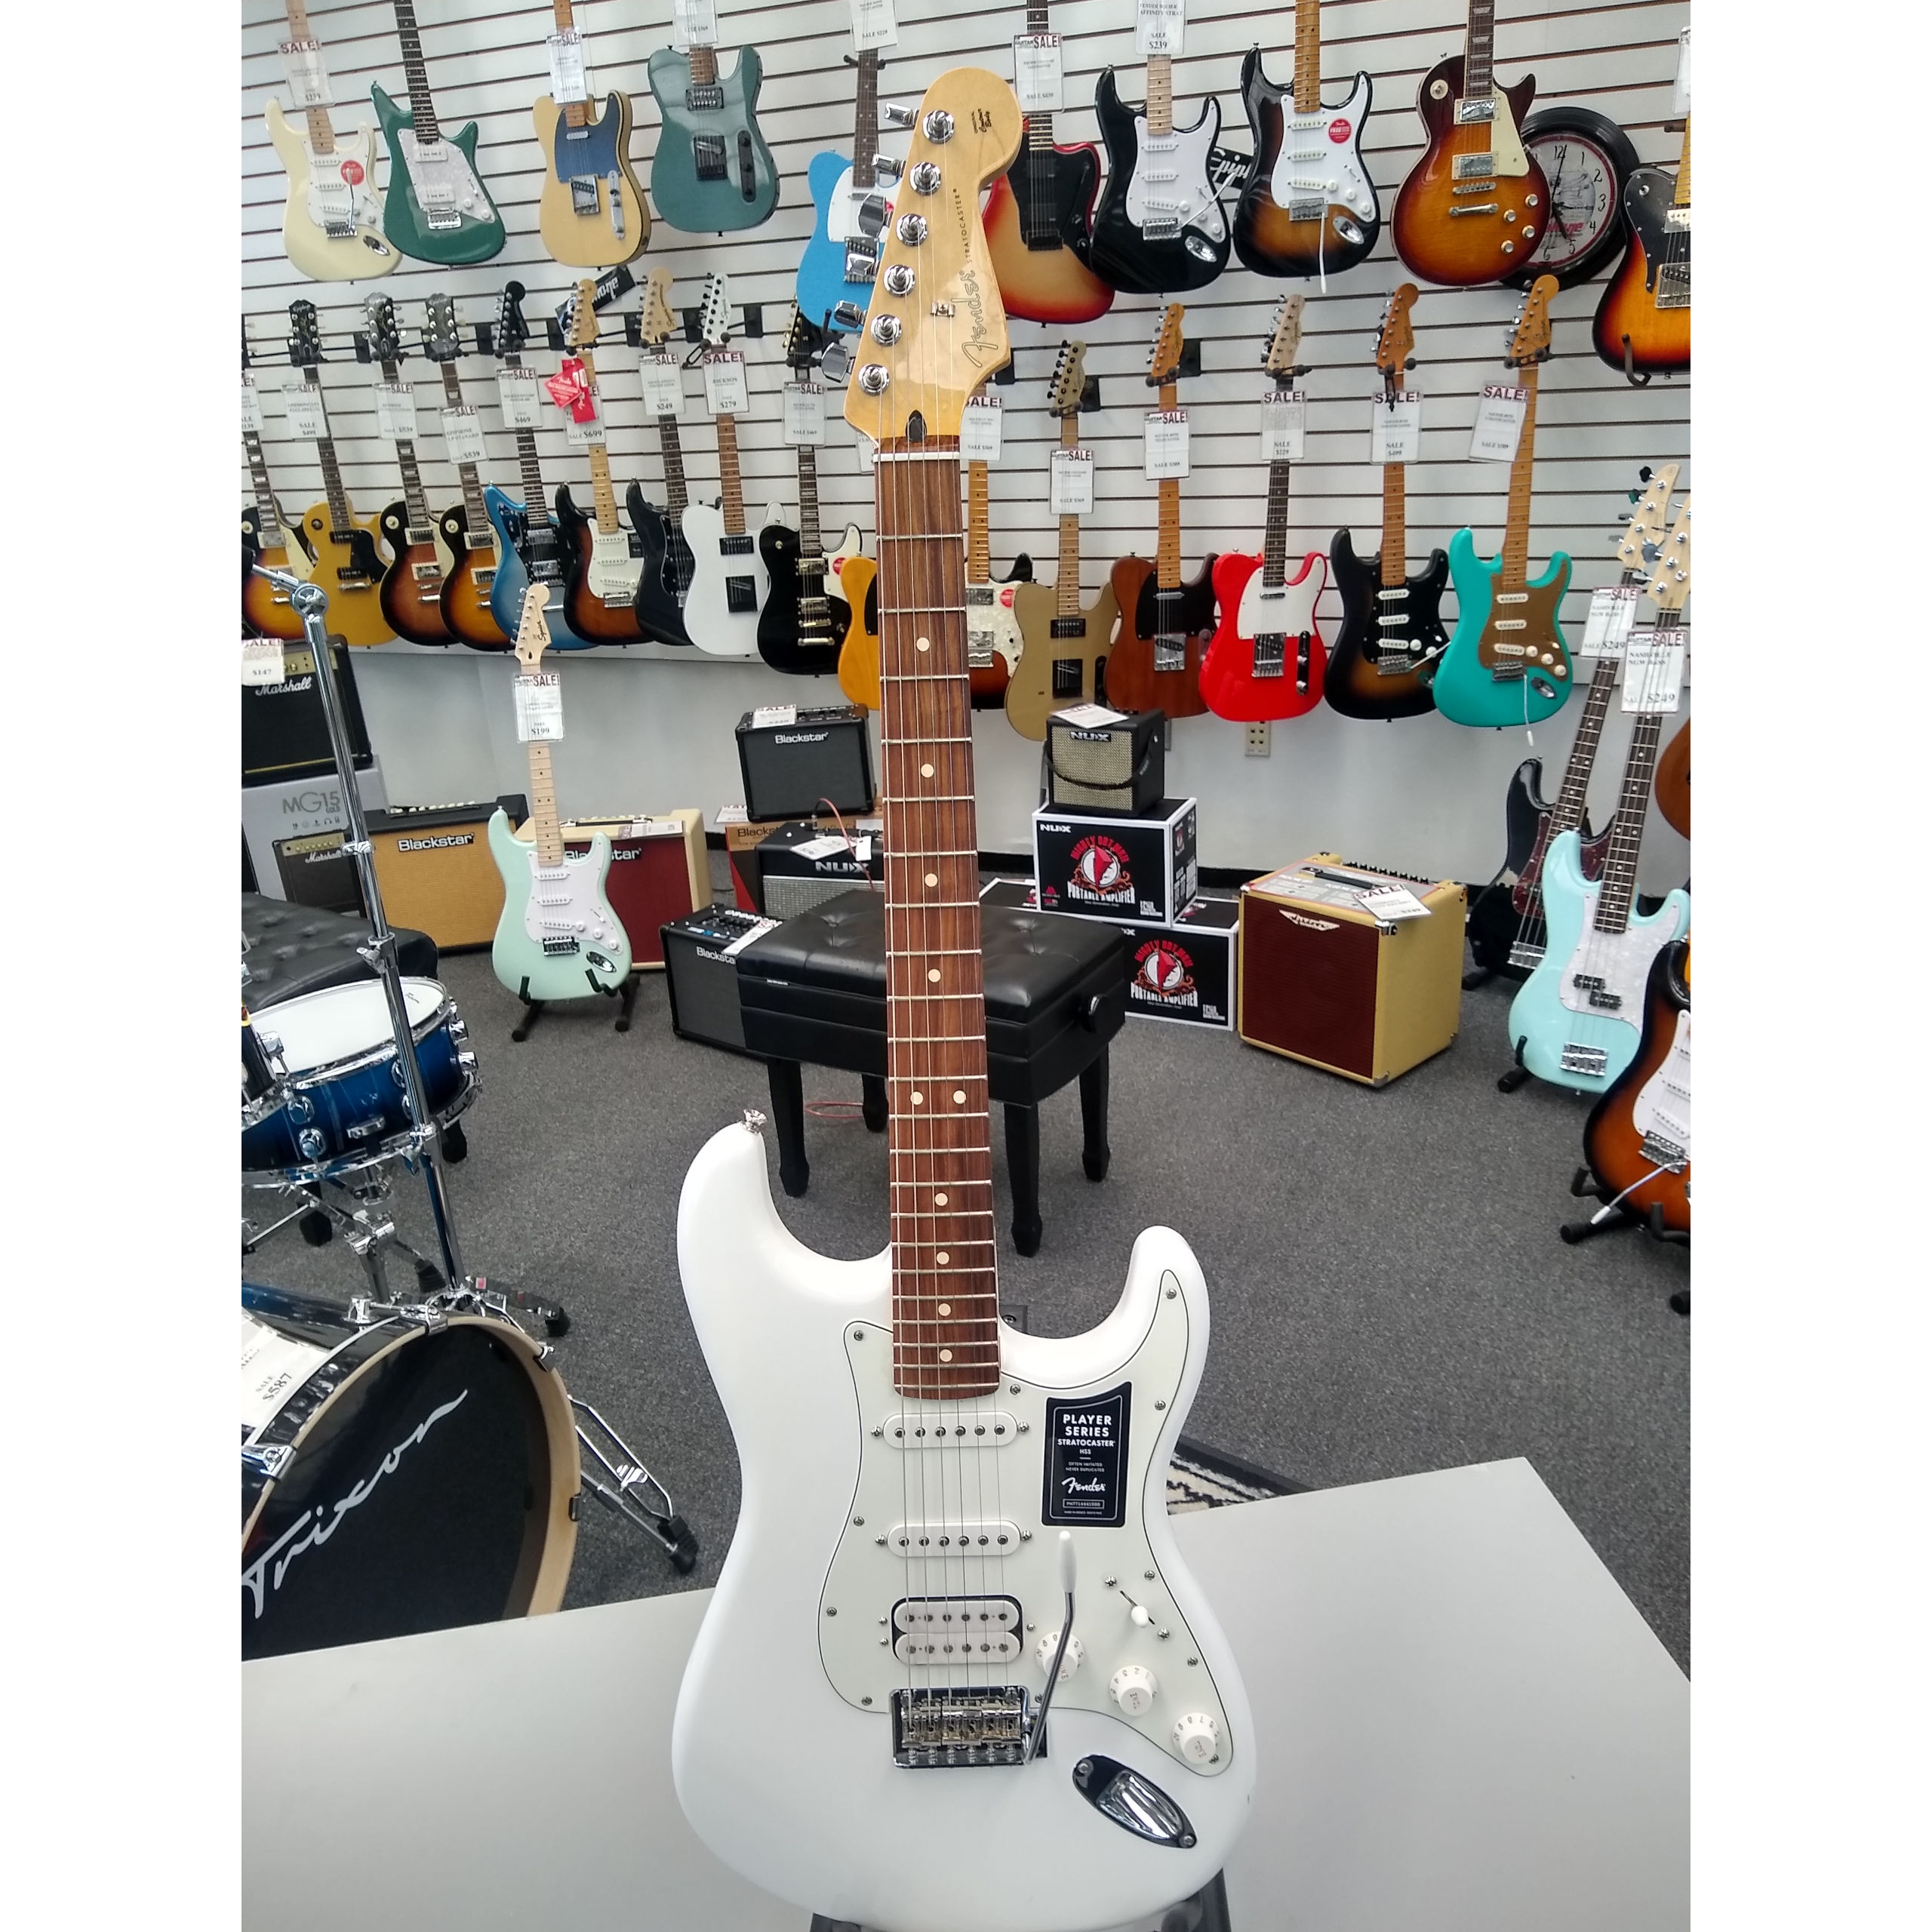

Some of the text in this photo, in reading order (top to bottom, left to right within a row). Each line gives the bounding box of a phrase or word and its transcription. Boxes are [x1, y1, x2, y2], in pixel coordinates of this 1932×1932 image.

[561, 32, 581, 47] SALE!
[1033, 35, 1061, 49] SALE!
[1149, 41, 1168, 49] $239
[280, 40, 321, 54] SALE!
[1555, 146, 1566, 162] 12
[1581, 151, 1585, 166] 1
[1594, 168, 1602, 183] 2
[1598, 193, 1606, 212] 3
[1589, 220, 1596, 235] 4
[1568, 239, 1577, 255] 5
[951, 269, 998, 368] Fender
[655, 353, 678, 365] SALE!
[704, 352, 743, 365] SALE!
[513, 368, 536, 380] SALE!
[391, 383, 414, 394] SALE!
[801, 383, 825, 395] SALE!
[1483, 386, 1528, 401] SALE!
[966, 397, 1002, 408] ALE!
[1264, 391, 1306, 404] SALE!
[455, 405, 478, 417] SALE!
[720, 401, 737, 409] $279
[1162, 411, 1189, 424] SALE!
[583, 429, 602, 438] $699
[1069, 449, 1094, 462] SALE!
[1601, 641, 1626, 650] $249
[1653, 632, 1684, 647] SALE!
[255, 676, 312, 697] Marshall
[533, 674, 560, 687] SALE!
[1647, 693, 1675, 703] $249
[774, 731, 829, 744] Blackstar
[398, 832, 475, 853] Blackstar
[565, 848, 642, 860] Blastar
[1066, 881, 1100, 901] PORTABLE
[1100, 886, 1136, 904] AMPLIFIER
[1354, 884, 1405, 899] SALE!
[696, 946, 735, 964] Blacksta
[1131, 982, 1198, 1008] PORTABLE AMPLIFIER
[262, 1373, 293, 1401] $587
[1063, 1414, 1112, 1426] PLAYER
[1065, 1426, 1109, 1438] SERIES
[1062, 1477, 1106, 1494] Fender
